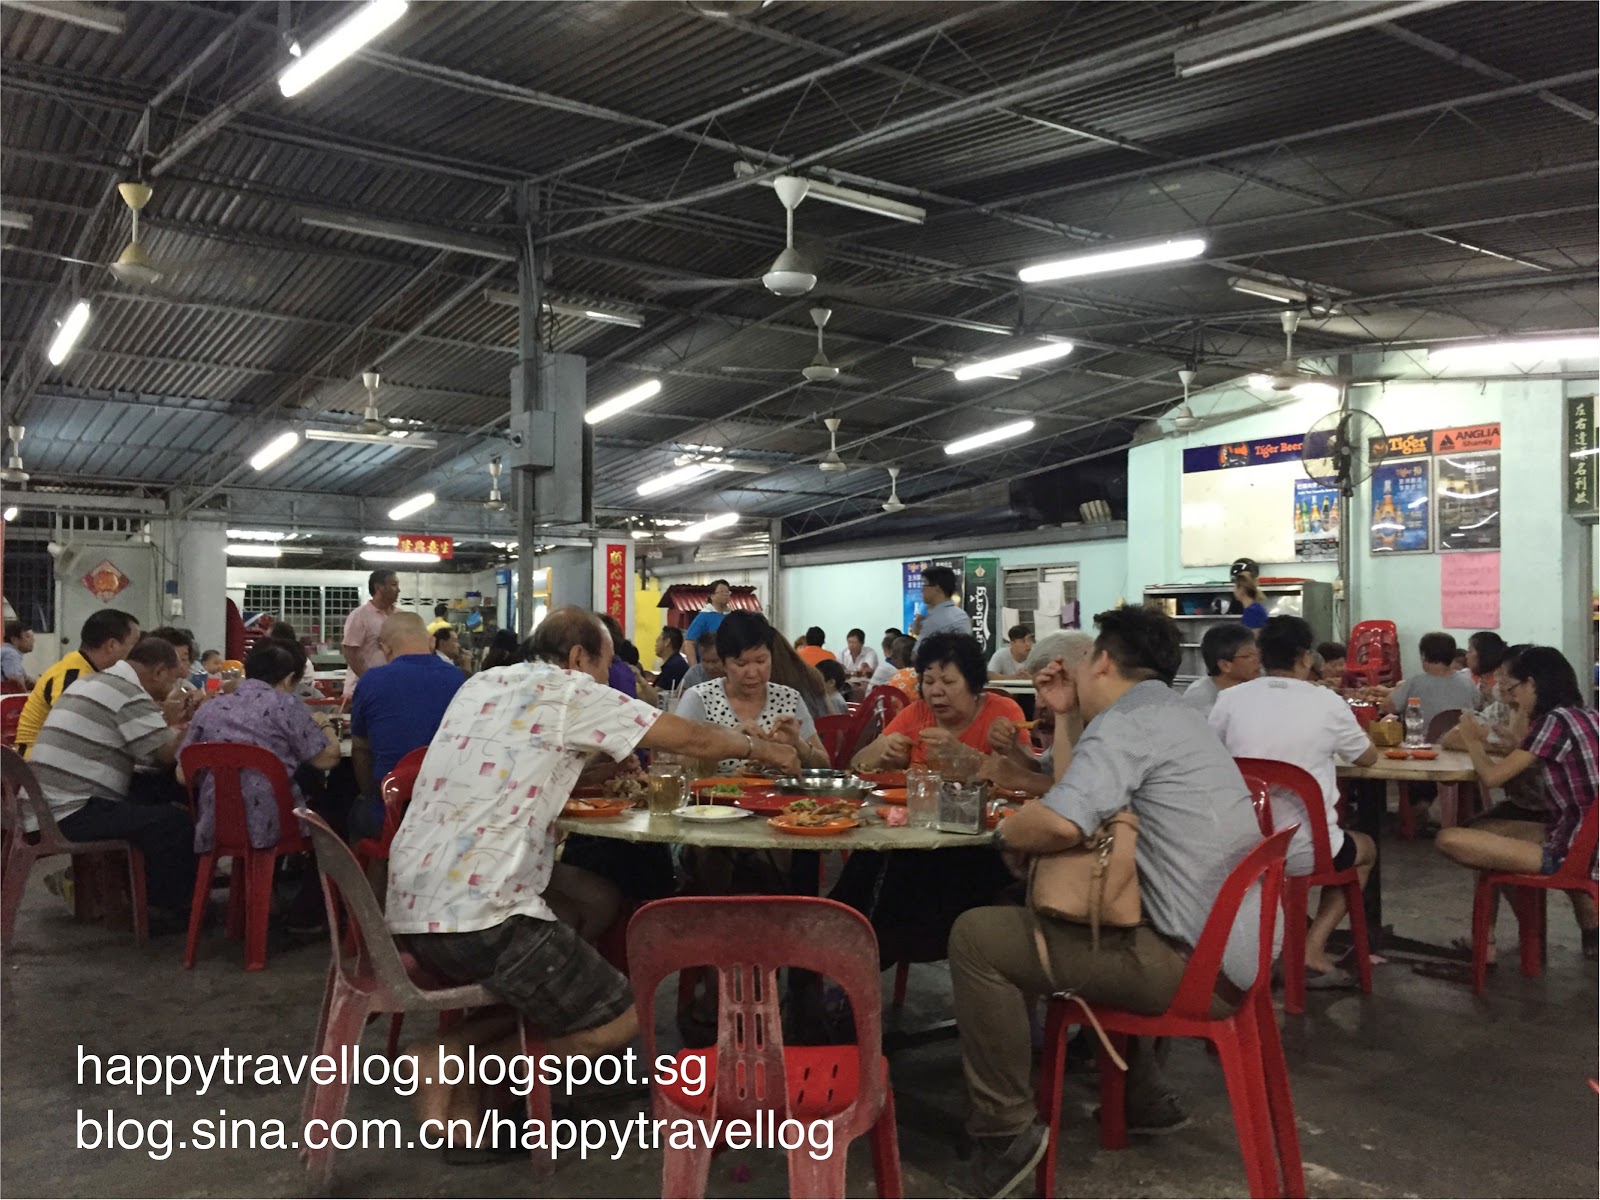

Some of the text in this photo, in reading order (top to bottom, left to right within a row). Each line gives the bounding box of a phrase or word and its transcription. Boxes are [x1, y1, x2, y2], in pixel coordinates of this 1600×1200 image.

[1456, 427, 1500, 440] ANGLIA
[1255, 442, 1303, 458] Tiger Beer
[1388, 434, 1428, 454] Tiger
[1463, 438, 1493, 448] Shandy
[971, 586, 990, 653] arlsberg
